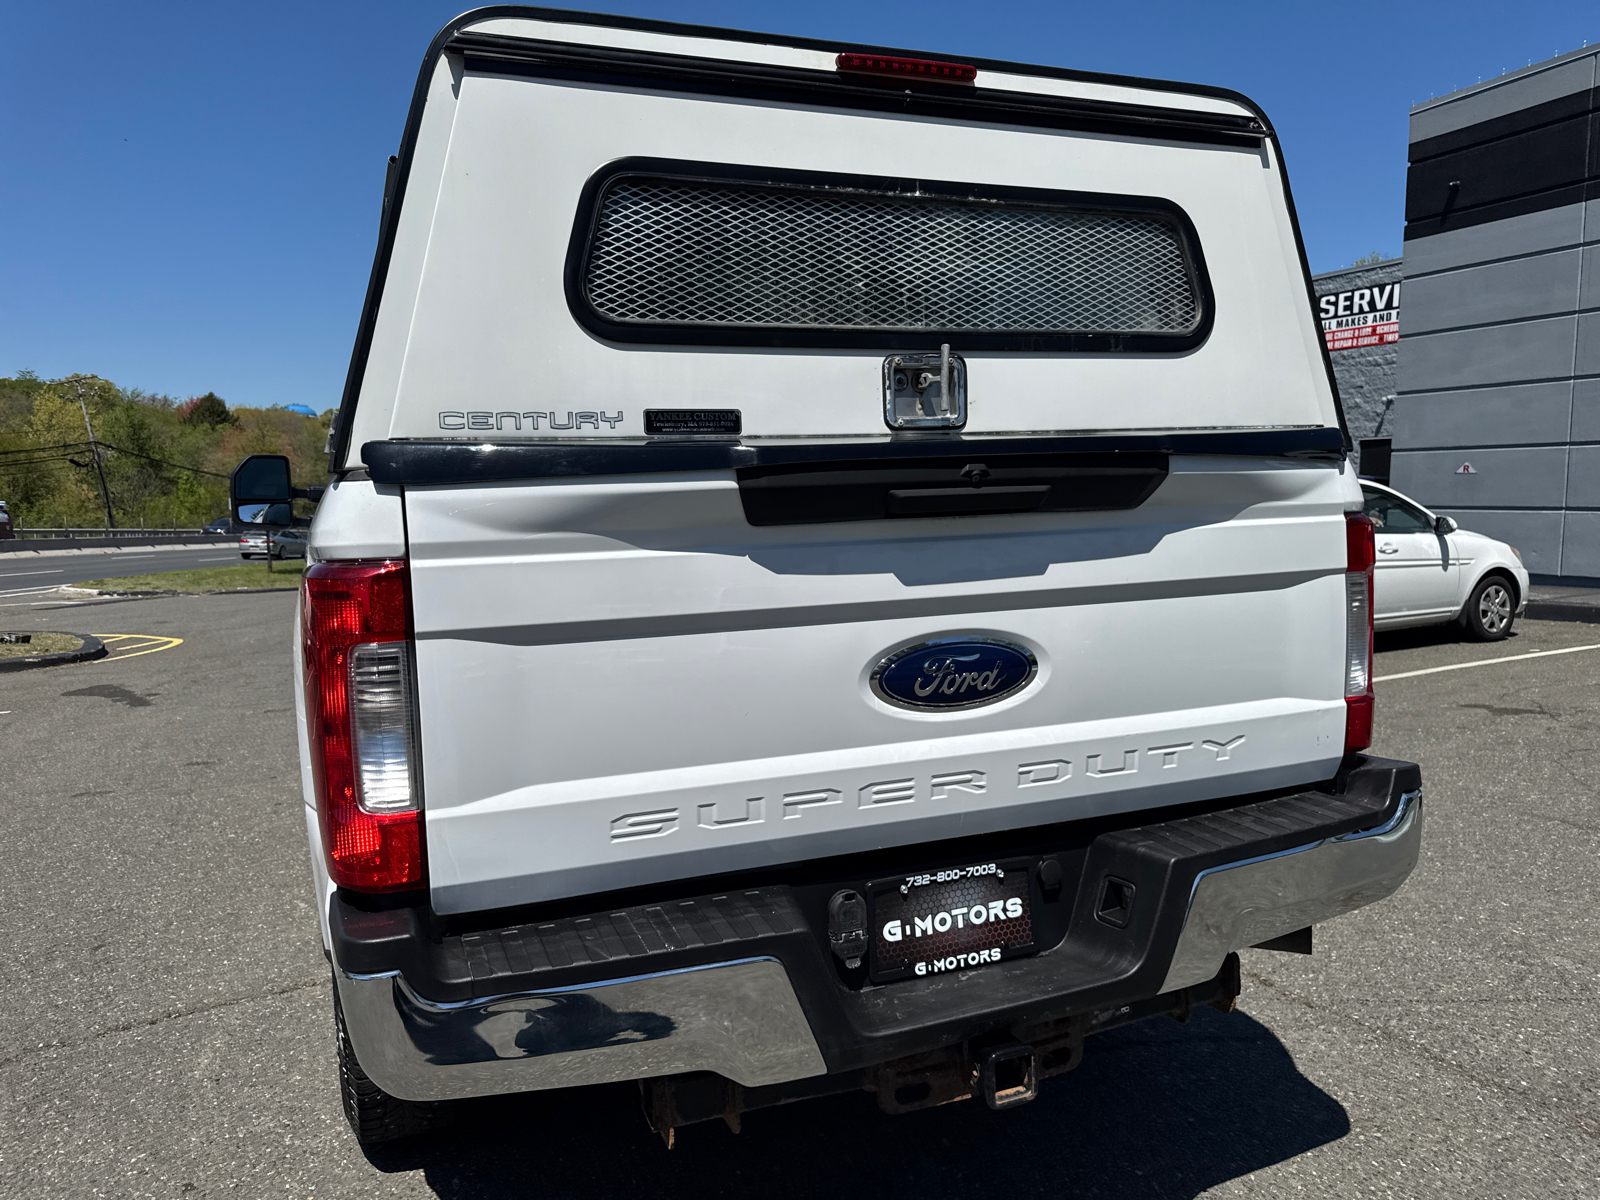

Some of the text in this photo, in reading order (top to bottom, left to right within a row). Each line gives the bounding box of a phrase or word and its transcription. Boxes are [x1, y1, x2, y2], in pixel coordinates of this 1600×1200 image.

[1320, 283, 1400, 319] SERVI
[1336, 316, 1368, 329] MAKES
[1372, 312, 1392, 324] AND
[438, 410, 624, 431] CENTURY
[649, 412, 736, 421] YANKEE CUSTOM
[1462, 464, 1470, 473] R
[913, 653, 1007, 697] Ford
[610, 734, 1246, 843] SUPER DUTY
[905, 863, 997, 887] 732-800-7003
